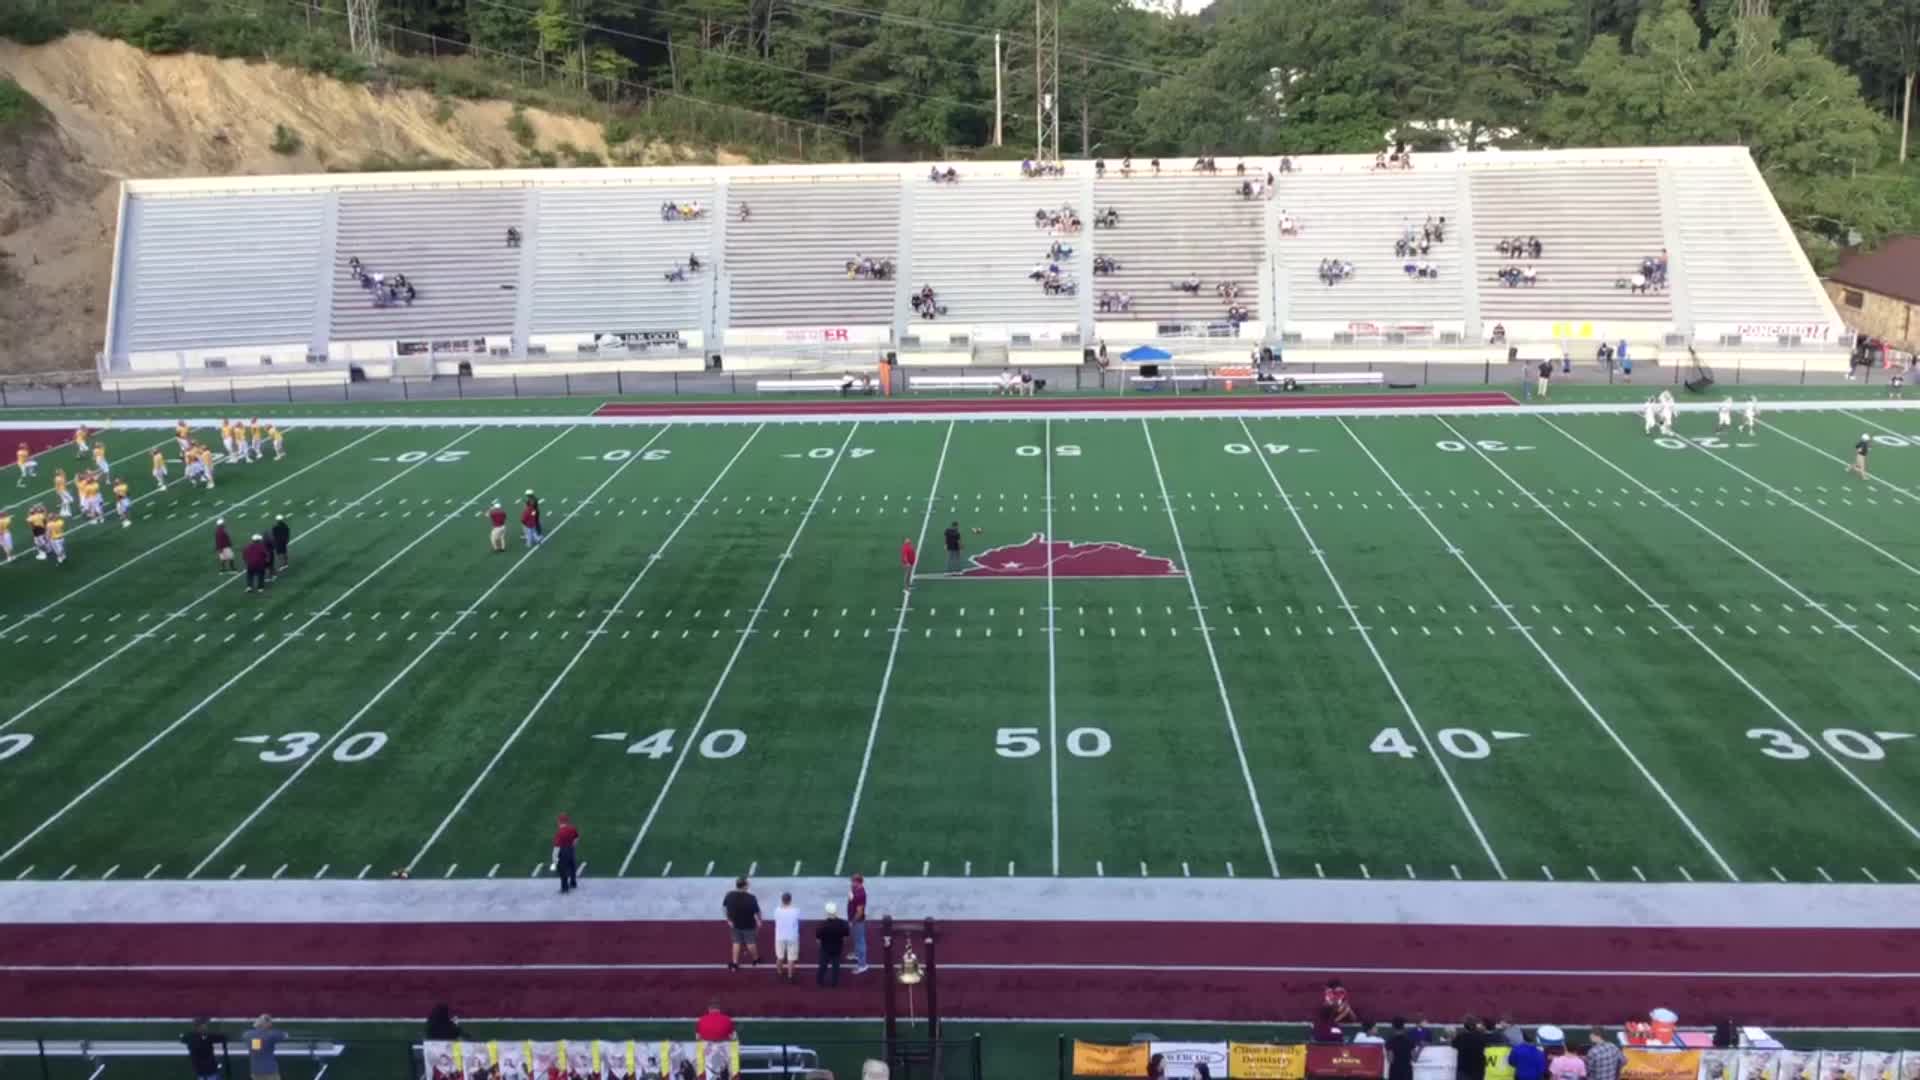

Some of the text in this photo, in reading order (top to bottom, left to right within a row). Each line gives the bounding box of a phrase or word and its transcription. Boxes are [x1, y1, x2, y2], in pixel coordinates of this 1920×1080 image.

[1015, 445, 1081, 456] 50
[1223, 443, 1290, 454] 40
[1436, 440, 1509, 451] 30
[396, 451, 470, 462] 20
[602, 450, 671, 461] 30
[808, 448, 875, 458] 40
[258, 732, 388, 762] 30
[626, 729, 748, 759] 40
[995, 728, 1112, 758] 50
[1369, 728, 1491, 759] 40
[1746, 729, 1885, 761] 30
